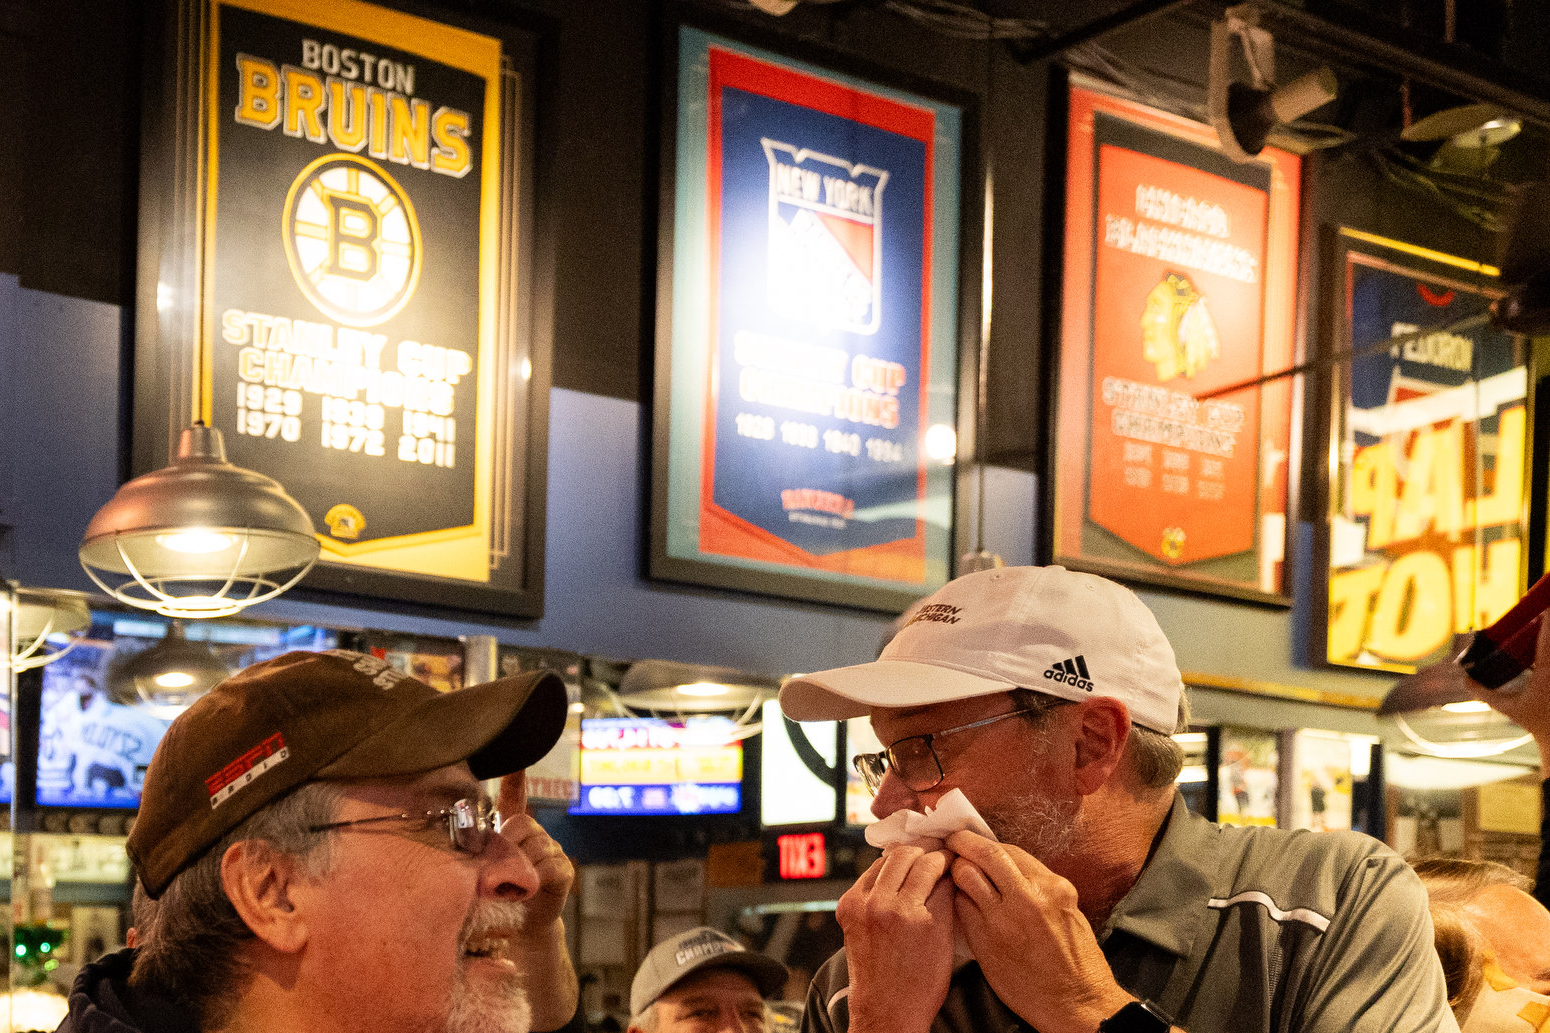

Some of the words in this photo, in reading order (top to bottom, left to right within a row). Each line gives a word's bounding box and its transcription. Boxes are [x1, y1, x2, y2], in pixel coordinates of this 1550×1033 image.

[302, 38, 415, 95] BOSTON
[235, 52, 473, 179] BRUINS
[777, 162, 821, 203] NEW
[822, 175, 875, 217] YORK
[236, 381, 302, 416] 1929
[236, 407, 301, 442] 1970
[321, 421, 386, 457] 1972
[397, 434, 456, 469] 2011
[1043, 668, 1095, 693] adidas
